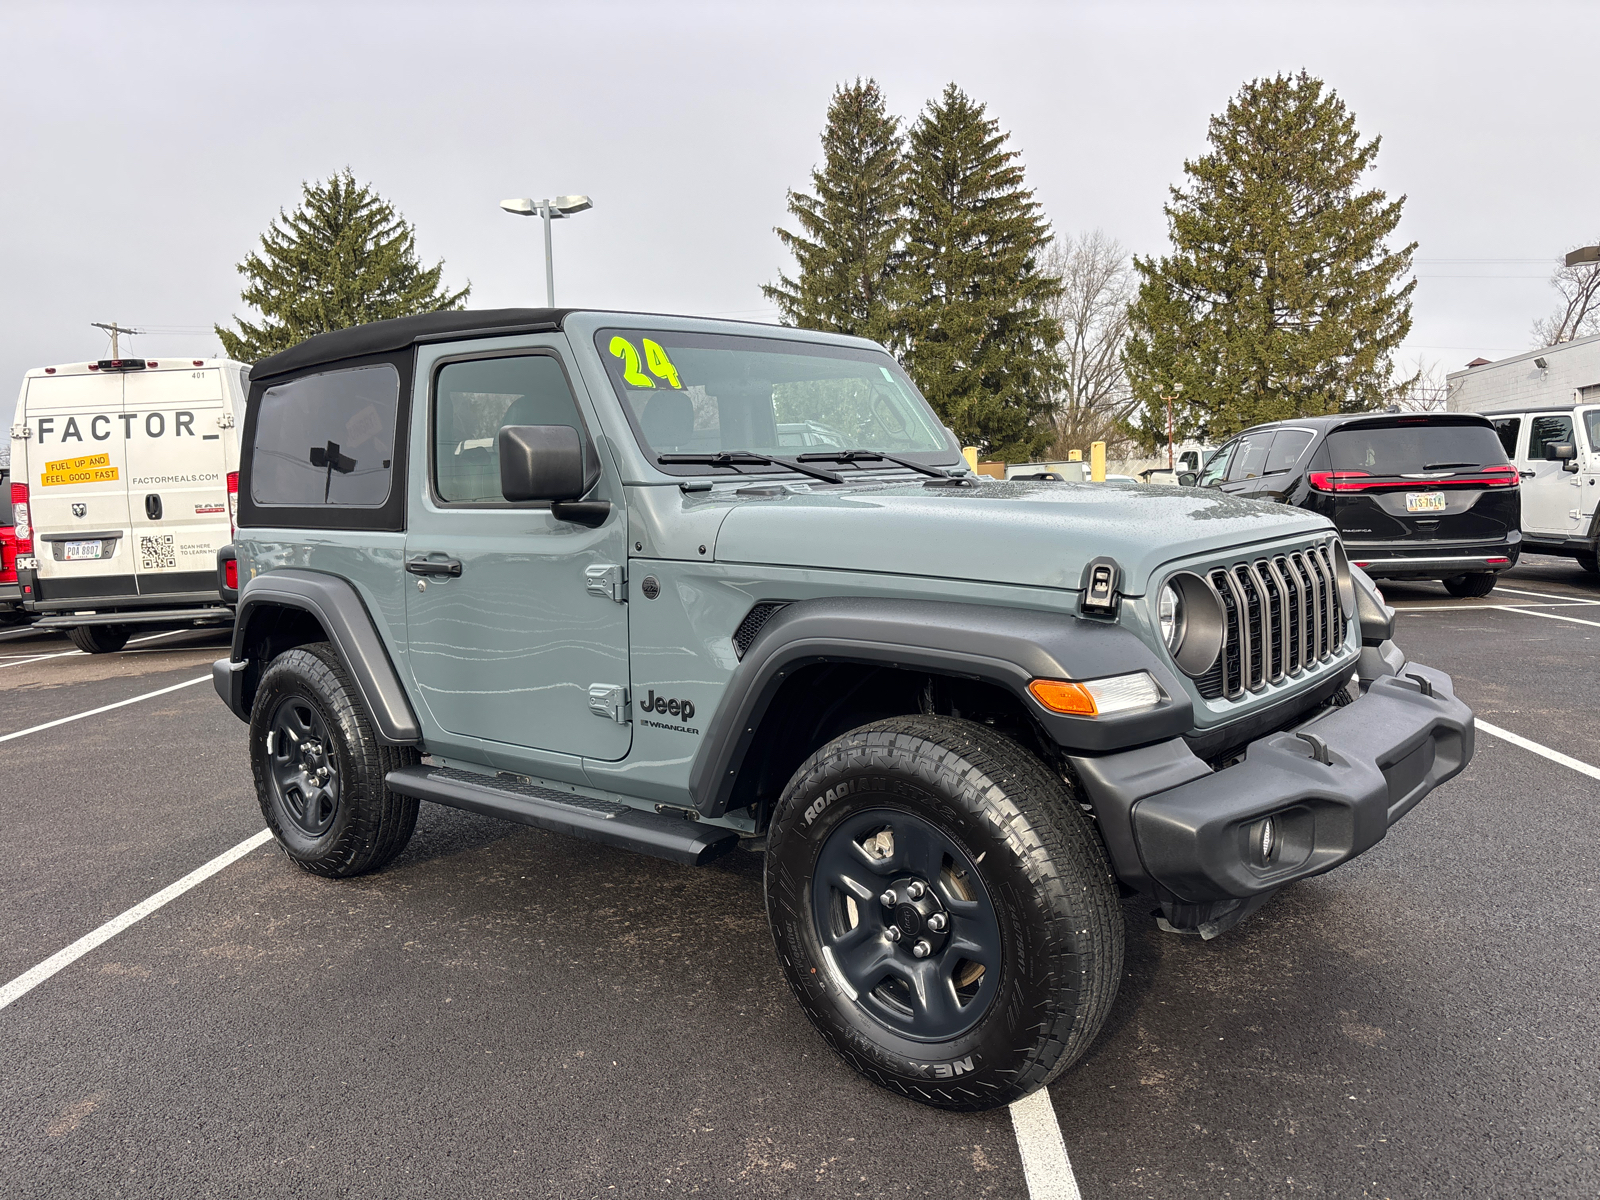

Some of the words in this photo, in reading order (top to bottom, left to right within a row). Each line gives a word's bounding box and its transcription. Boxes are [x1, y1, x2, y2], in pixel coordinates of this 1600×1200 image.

[609, 336, 682, 389] 24
[50, 462, 71, 472] FUEL
[74, 460, 86, 468] UP
[90, 456, 106, 466] AND
[46, 475, 66, 484] FEEL
[69, 472, 90, 482] GOOD
[95, 470, 115, 479] FAST
[132, 474, 218, 484] FACTORMEALS.COM
[82, 546, 98, 555] 8807
[640, 689, 695, 722] Jeep
[648, 720, 700, 736] WRANGLER
[804, 777, 886, 826] ROADIAN
[1008, 904, 1026, 975] 245/75R17
